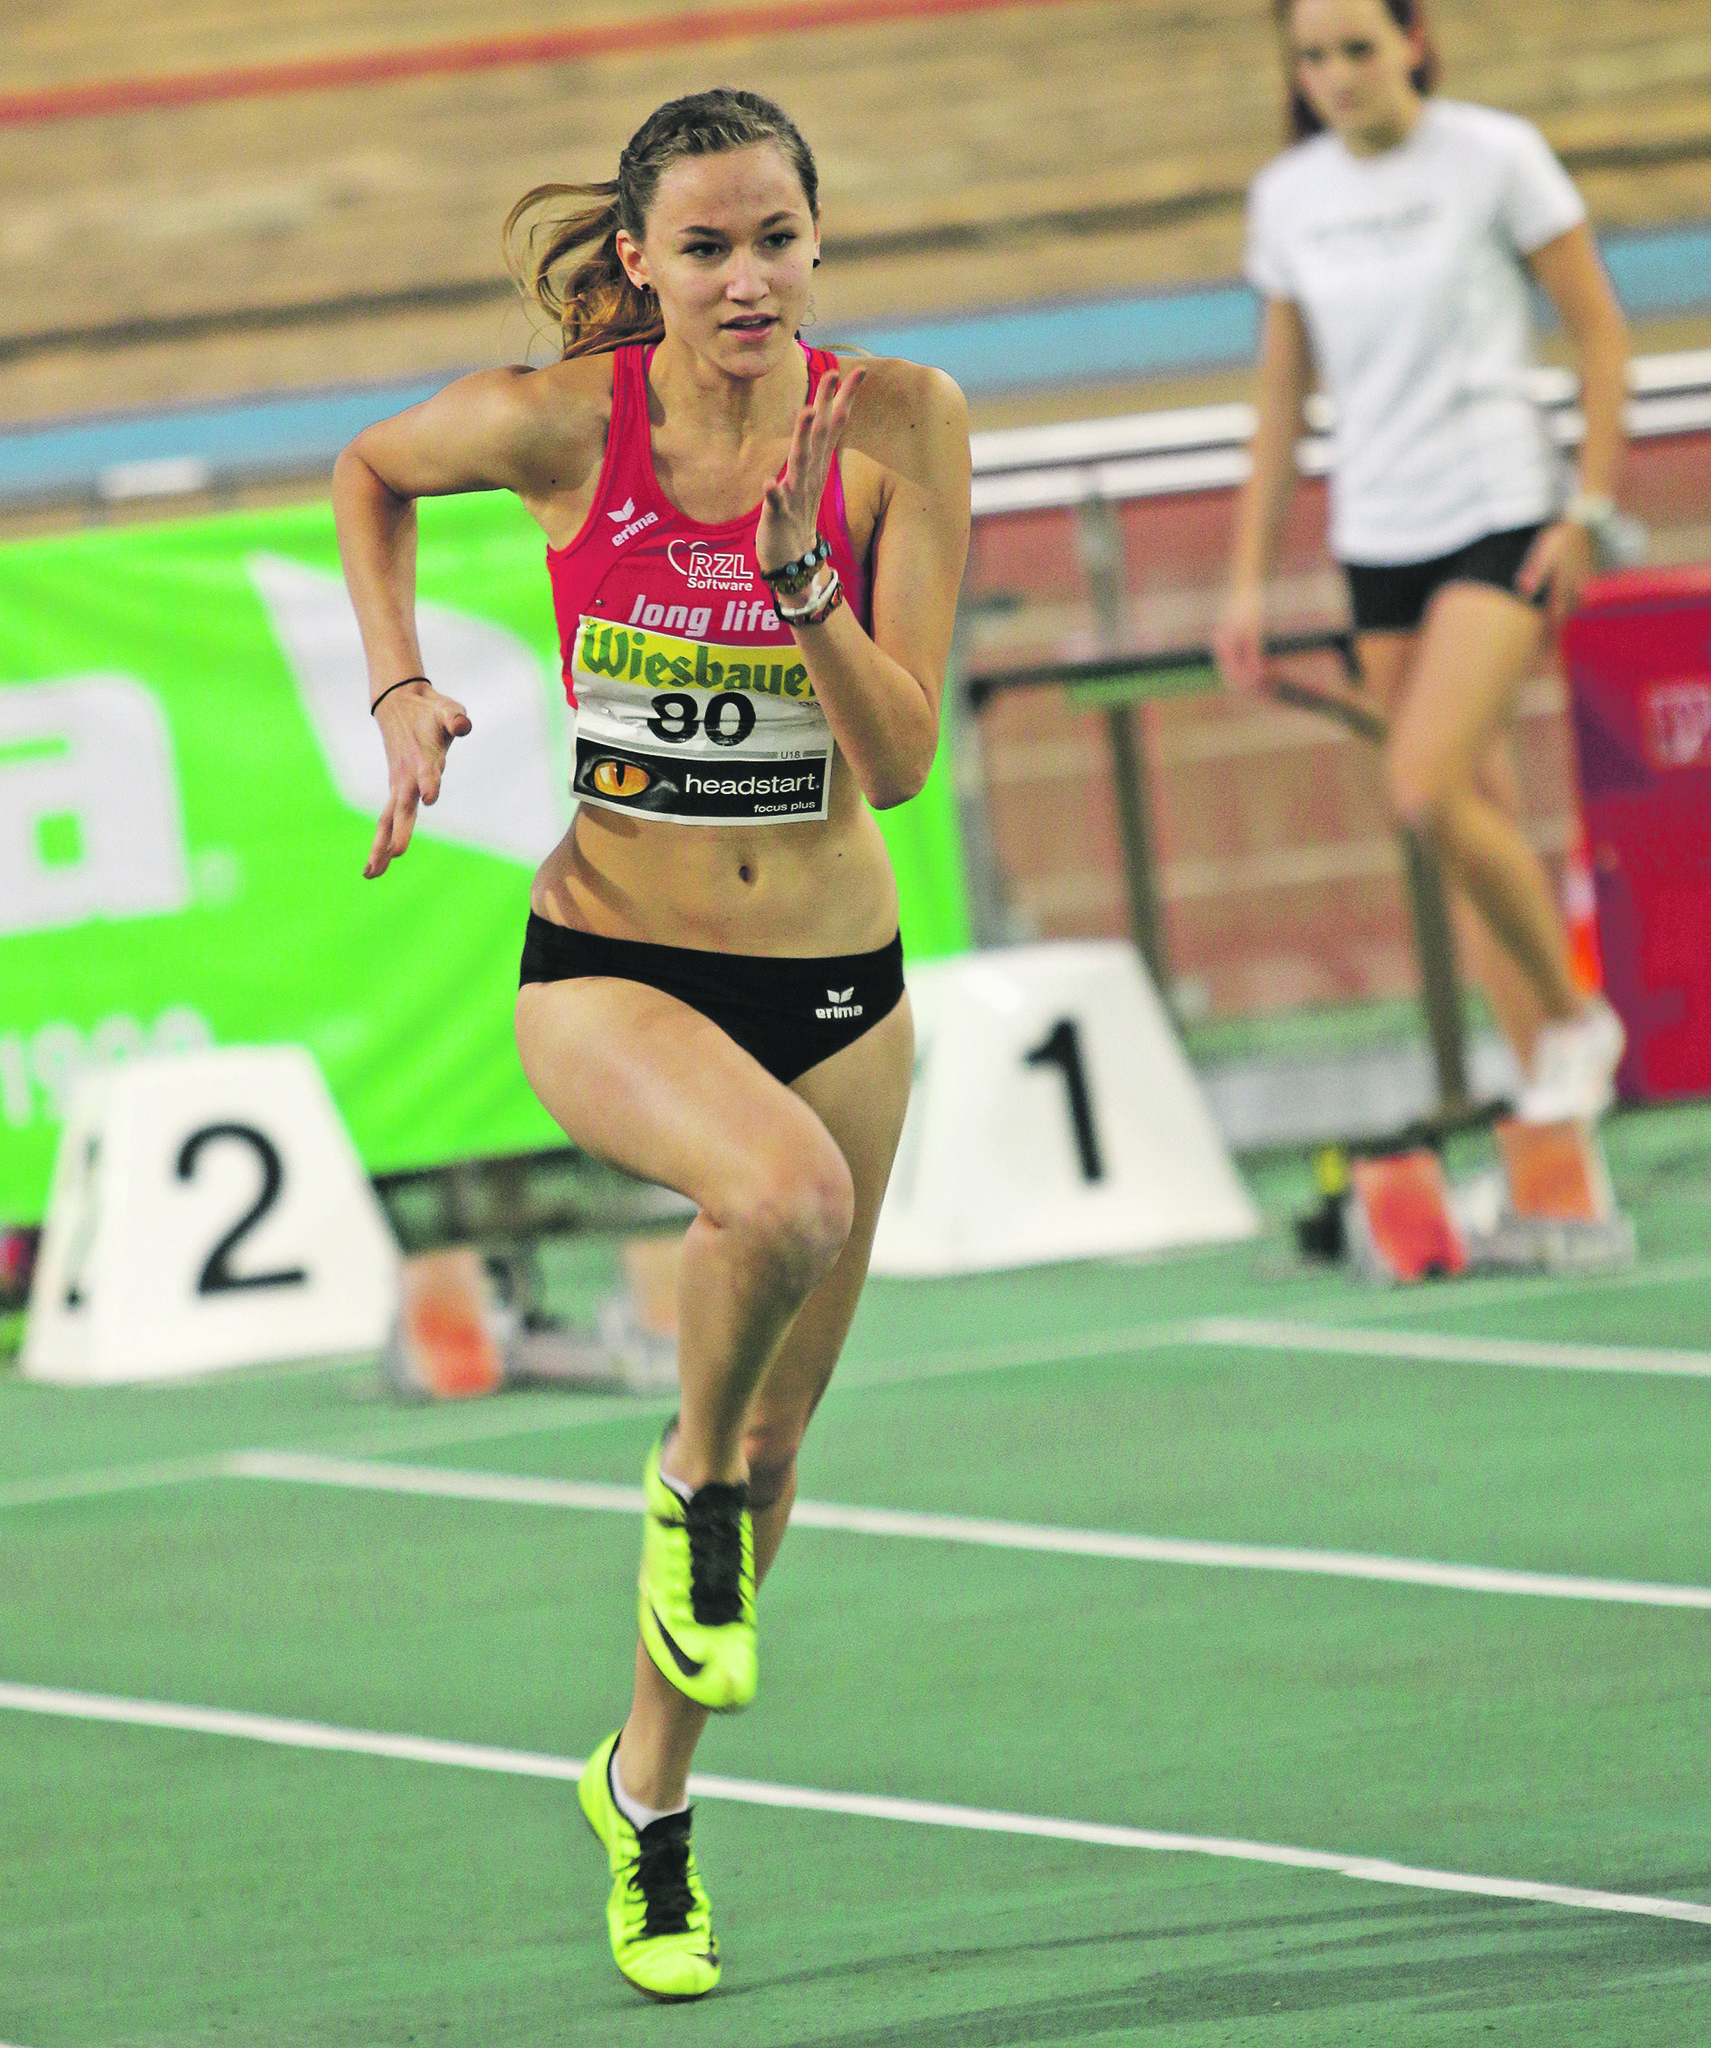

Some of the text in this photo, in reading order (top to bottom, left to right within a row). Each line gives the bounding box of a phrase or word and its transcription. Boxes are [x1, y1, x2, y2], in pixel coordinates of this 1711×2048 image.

[612, 511, 658, 547] erima
[689, 553, 754, 579] RZL
[687, 577, 753, 591] Software
[628, 594, 780, 637] long life
[780, 751, 801, 760] U18
[754, 801, 816, 813] focus plus
[815, 1004, 863, 1019] erima
[1026, 1020, 1105, 1183] 1
[176, 1121, 306, 1297] 2
